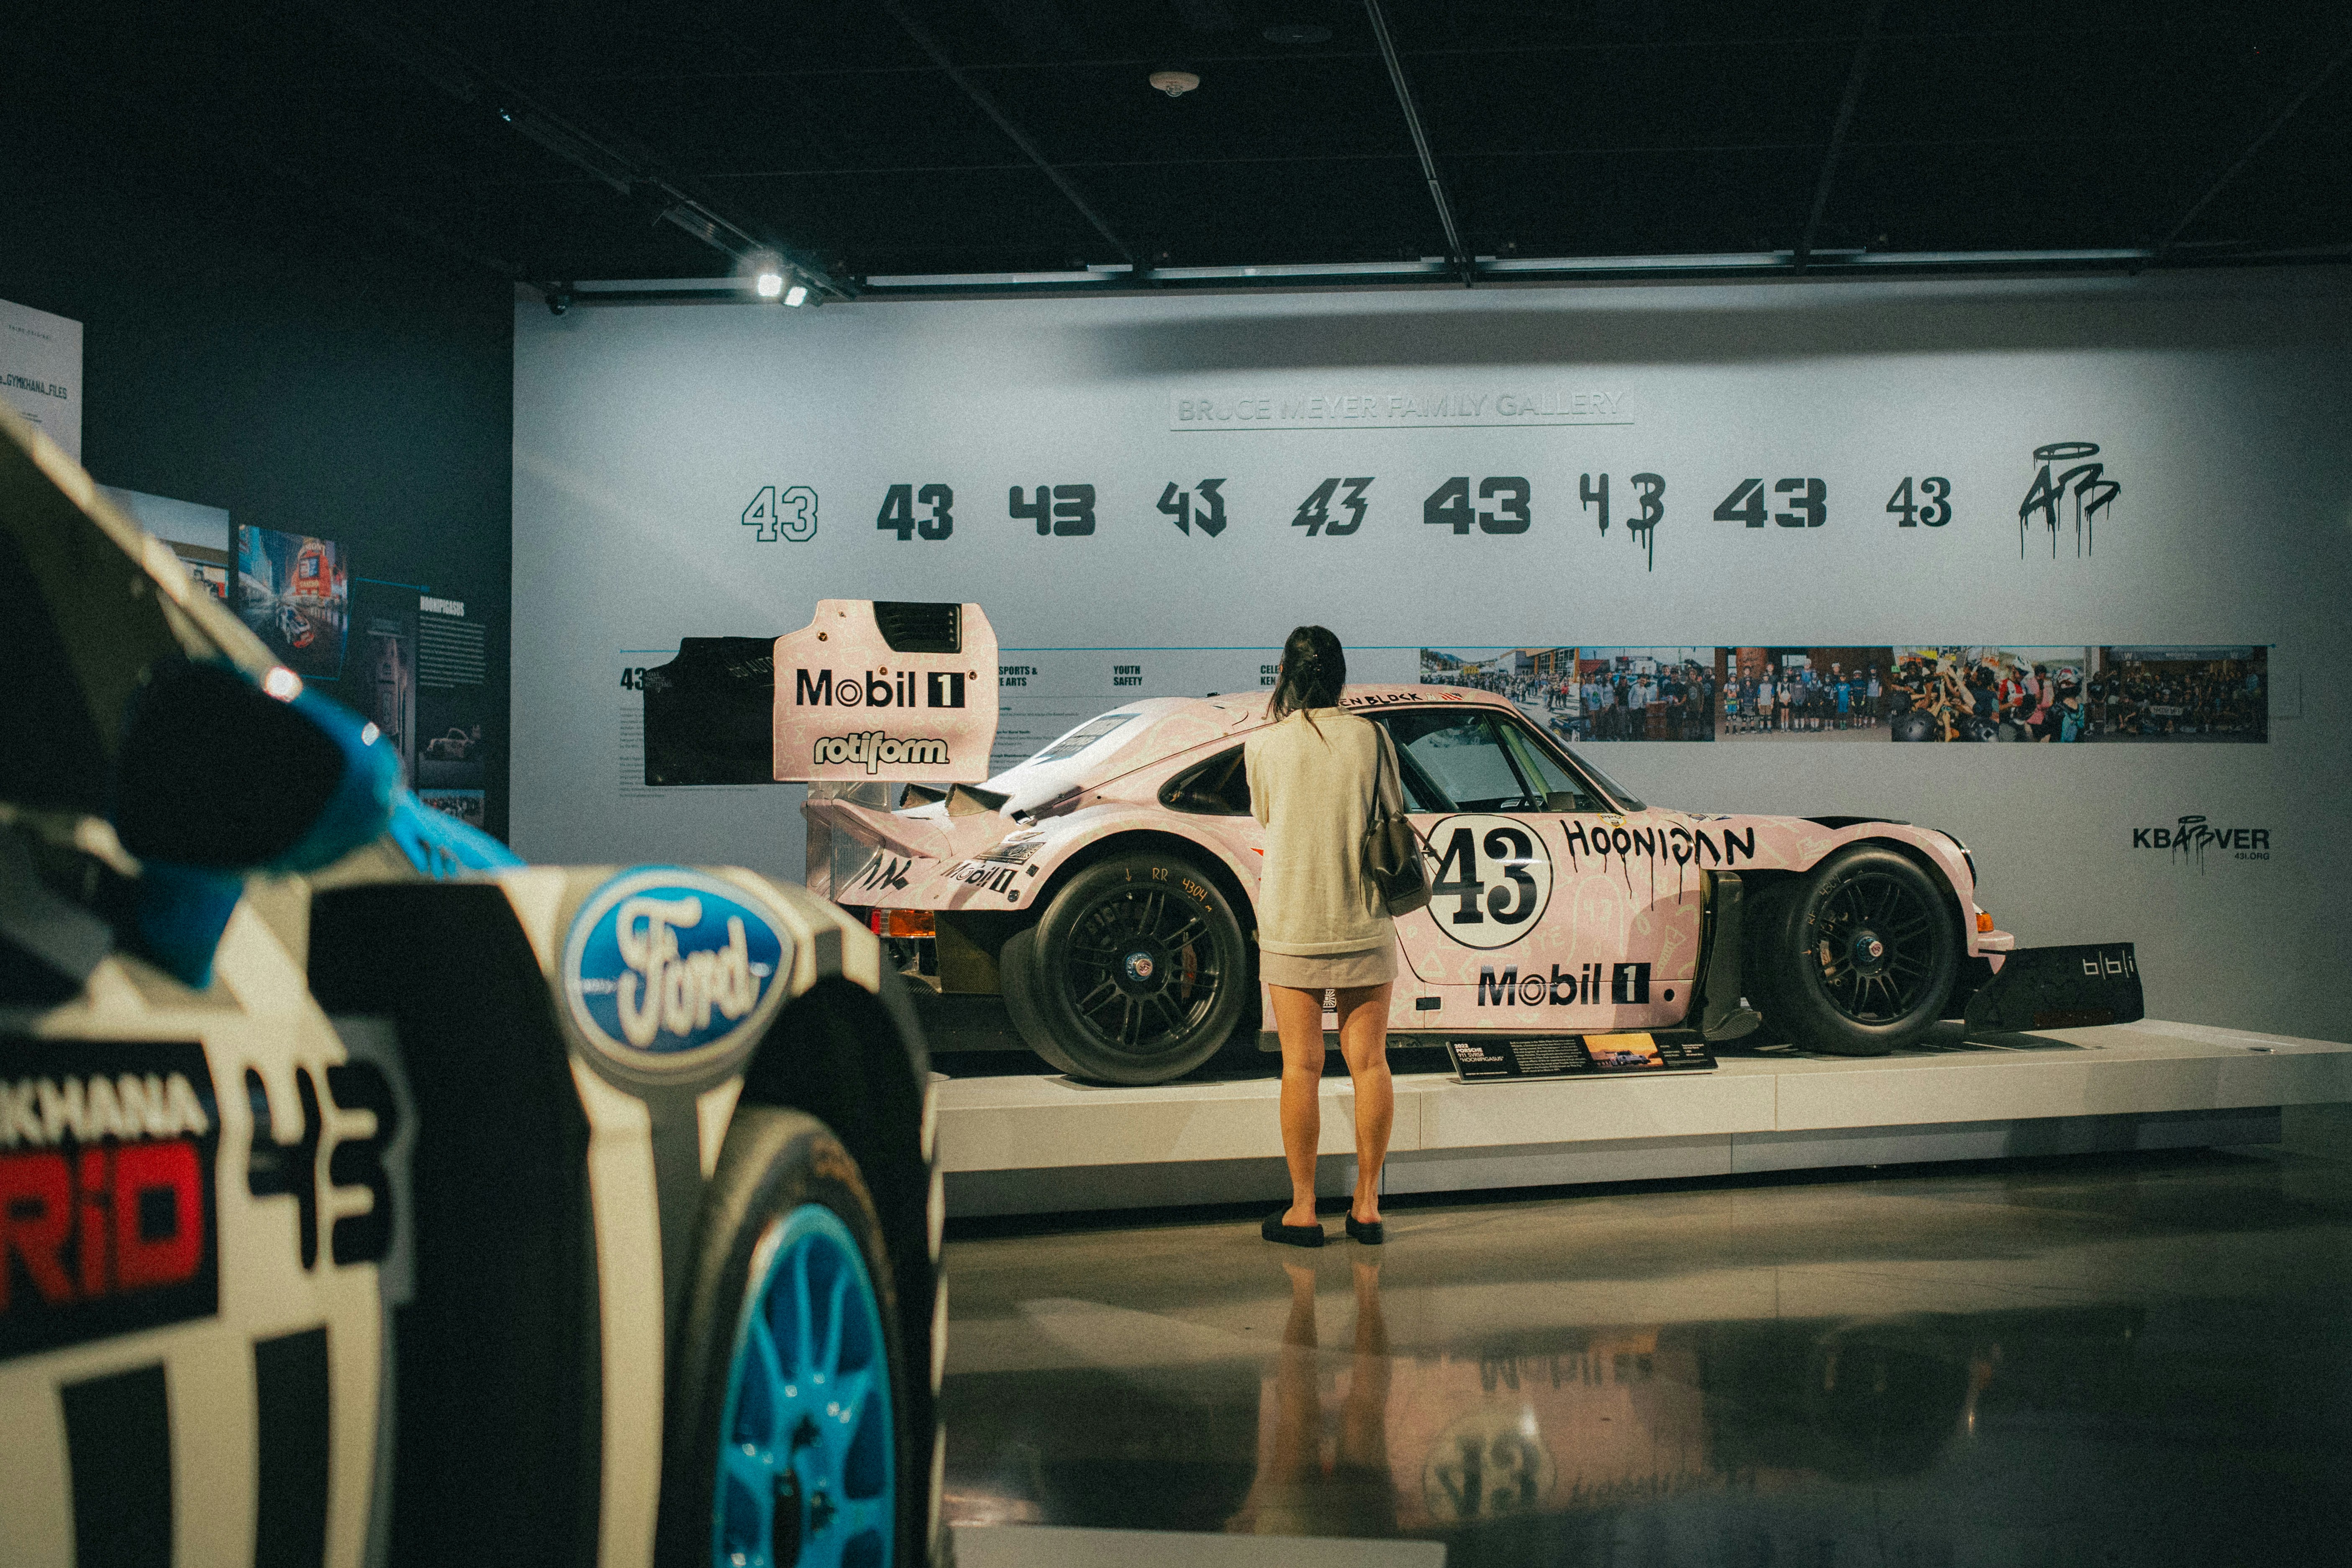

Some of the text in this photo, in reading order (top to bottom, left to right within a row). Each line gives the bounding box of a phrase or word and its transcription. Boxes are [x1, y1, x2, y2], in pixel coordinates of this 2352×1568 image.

[1178, 391, 1622, 421] BRUCE MEYER FAMILY GALLERY
[742, 486, 818, 542] 43
[876, 484, 954, 541] 43
[1009, 484, 1096, 536] 43
[1291, 477, 1376, 537] 43
[1423, 476, 1531, 535] 43
[1579, 473, 1666, 572] 43
[1713, 477, 1827, 528] 43
[1885, 476, 1952, 528] 43
[420, 595, 464, 617] HOONIPIGASUS
[620, 667, 646, 690] 43
[1005, 677, 1027, 686] ARTS
[1113, 665, 1141, 675] YOUTH
[1113, 677, 1143, 686] SAFETY
[1260, 665, 1280, 674] CELE
[1260, 676, 1276, 685] KEN
[796, 668, 916, 708] Mobil
[1340, 692, 1423, 706] EN BLOCK
[813, 730, 950, 775] rotiform
[940, 862, 1000, 888] Mobil
[1152, 867, 1169, 882] RR
[1432, 827, 1537, 924] 43
[1182, 878, 1208, 902] 4304
[616, 896, 760, 1048] Ford
[1477, 963, 1602, 1007] Mobil
[244, 1060, 398, 1271] 43
